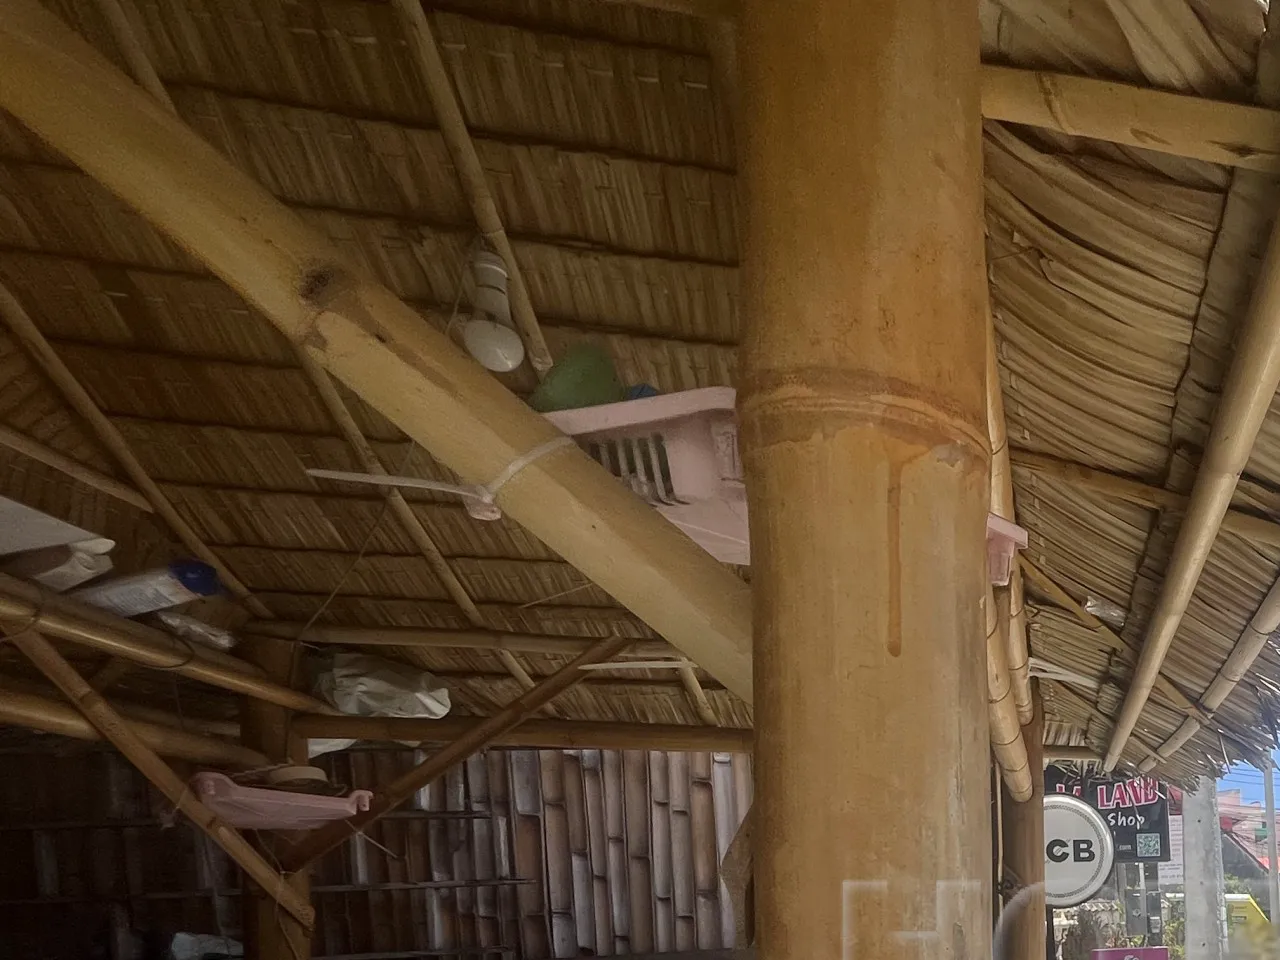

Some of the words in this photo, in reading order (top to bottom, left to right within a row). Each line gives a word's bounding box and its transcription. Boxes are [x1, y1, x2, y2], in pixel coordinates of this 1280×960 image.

[1097, 776, 1159, 810] LAND
[1107, 811, 1145, 830] Shop
[1046, 838, 1096, 863] CB
